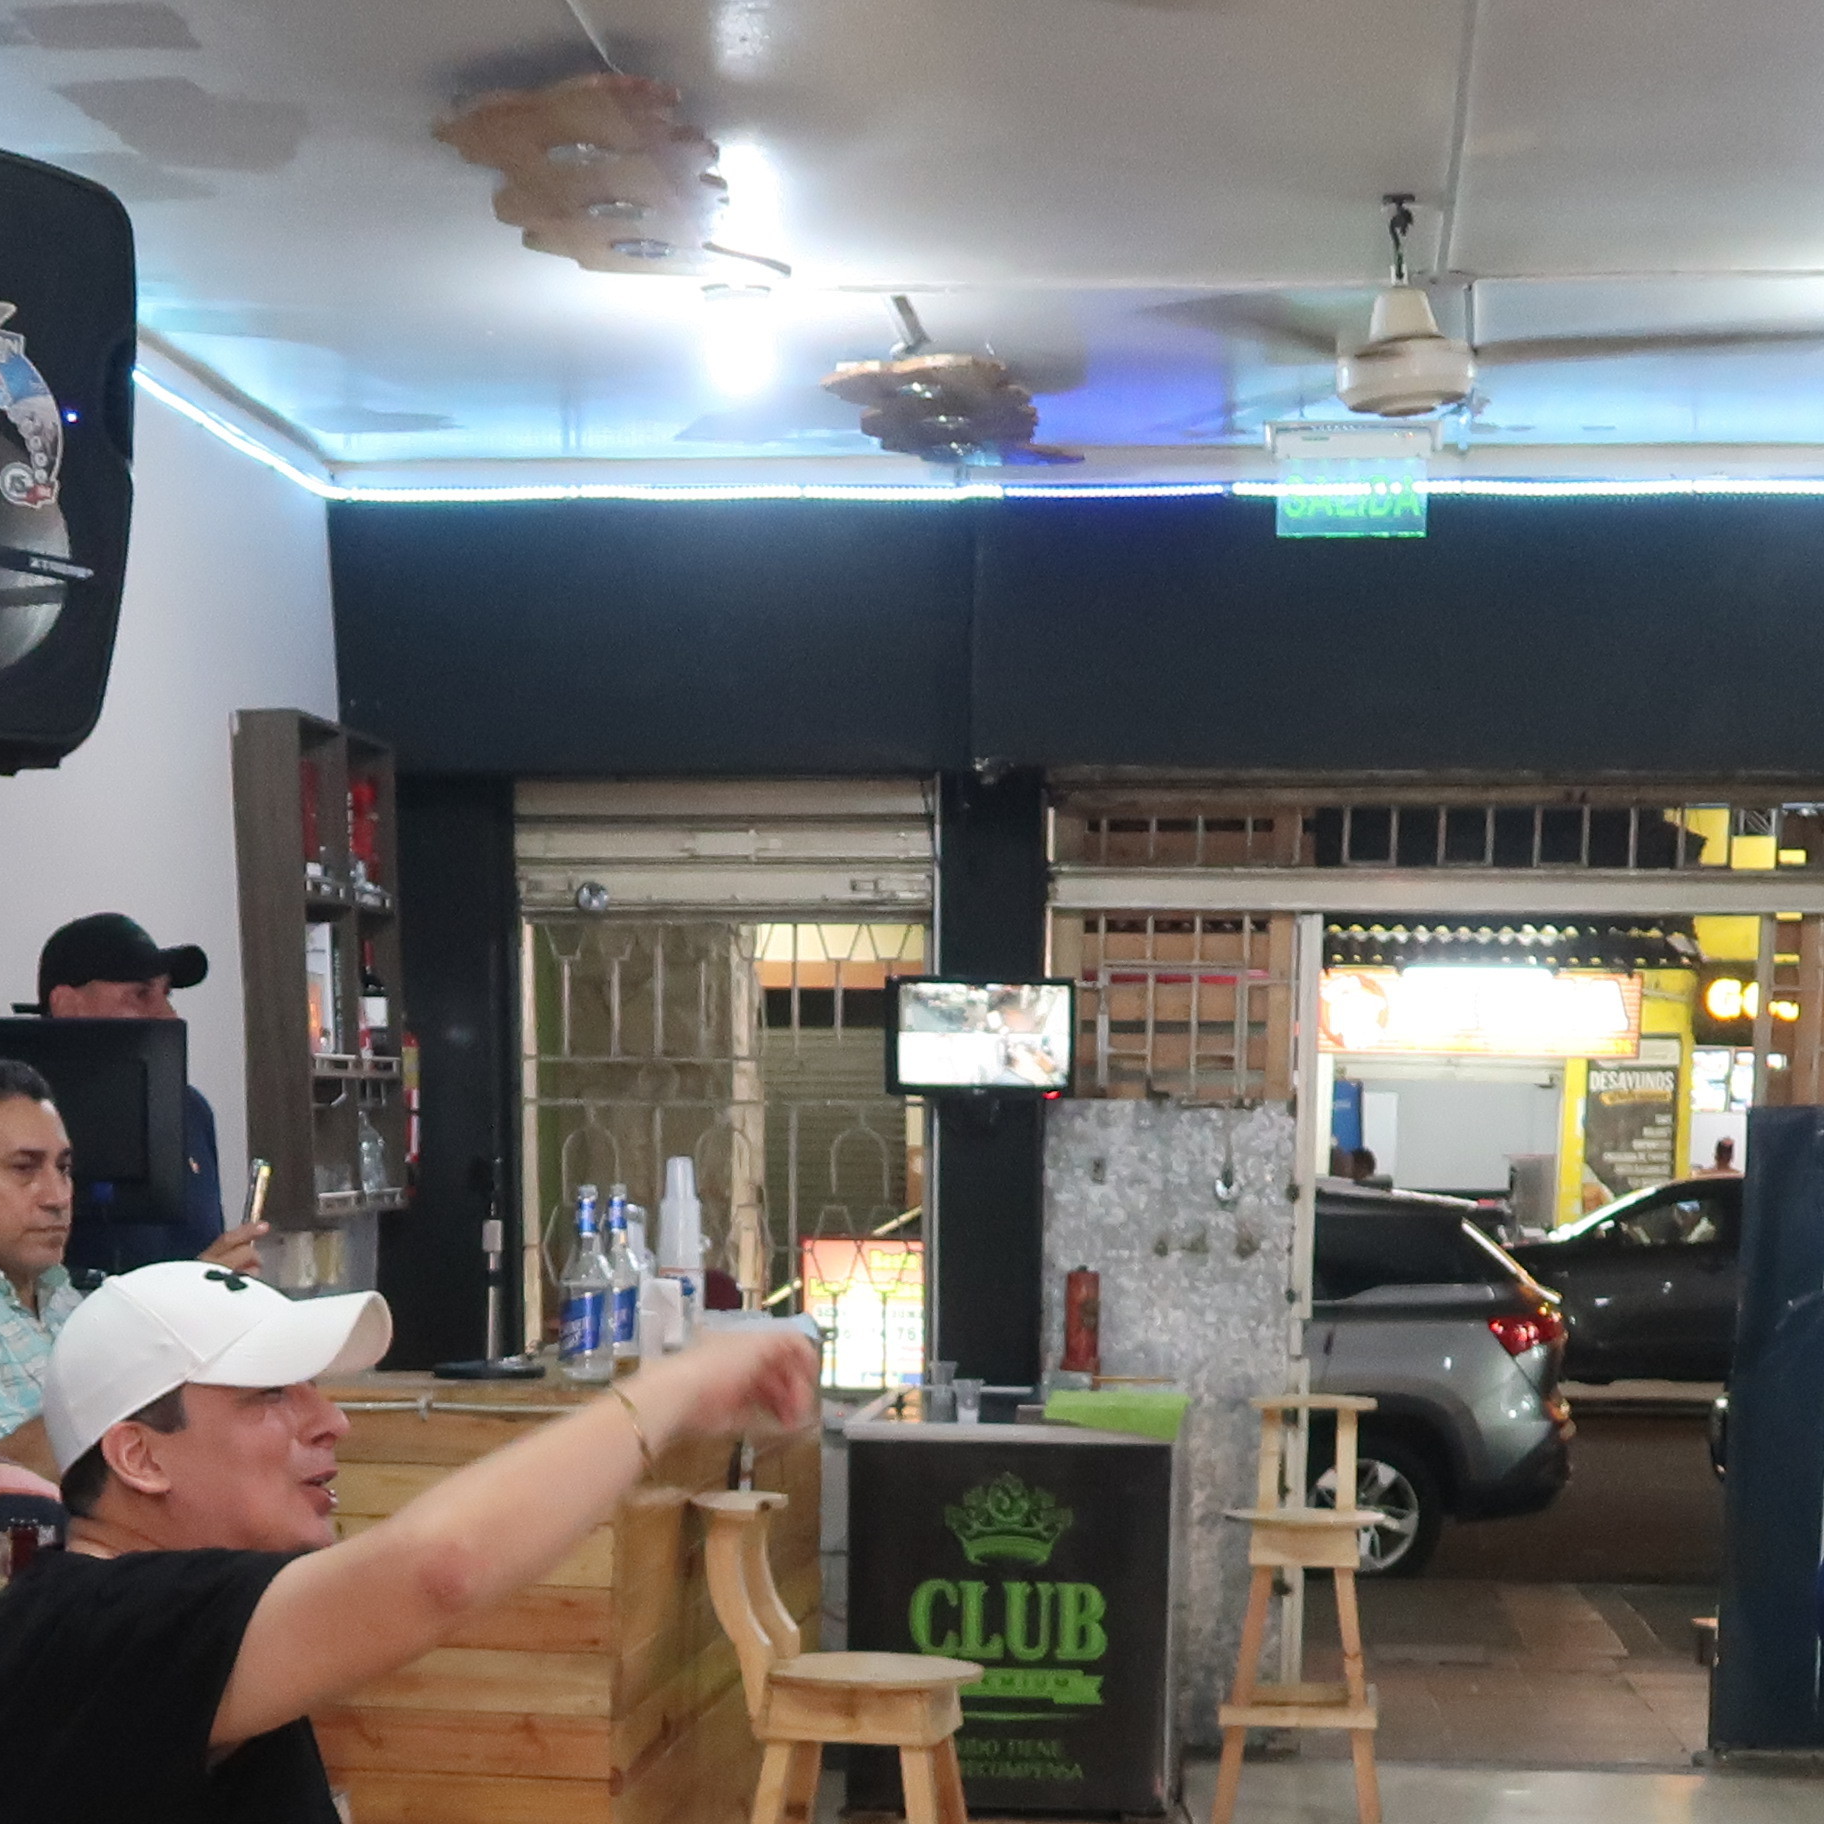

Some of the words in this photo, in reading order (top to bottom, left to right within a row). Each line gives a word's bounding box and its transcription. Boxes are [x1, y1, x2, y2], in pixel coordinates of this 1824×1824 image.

[1284, 474, 1423, 518] SALIDA
[1589, 1070, 1675, 1091] DESAYUNOS
[909, 1579, 1109, 1661] CLUB
